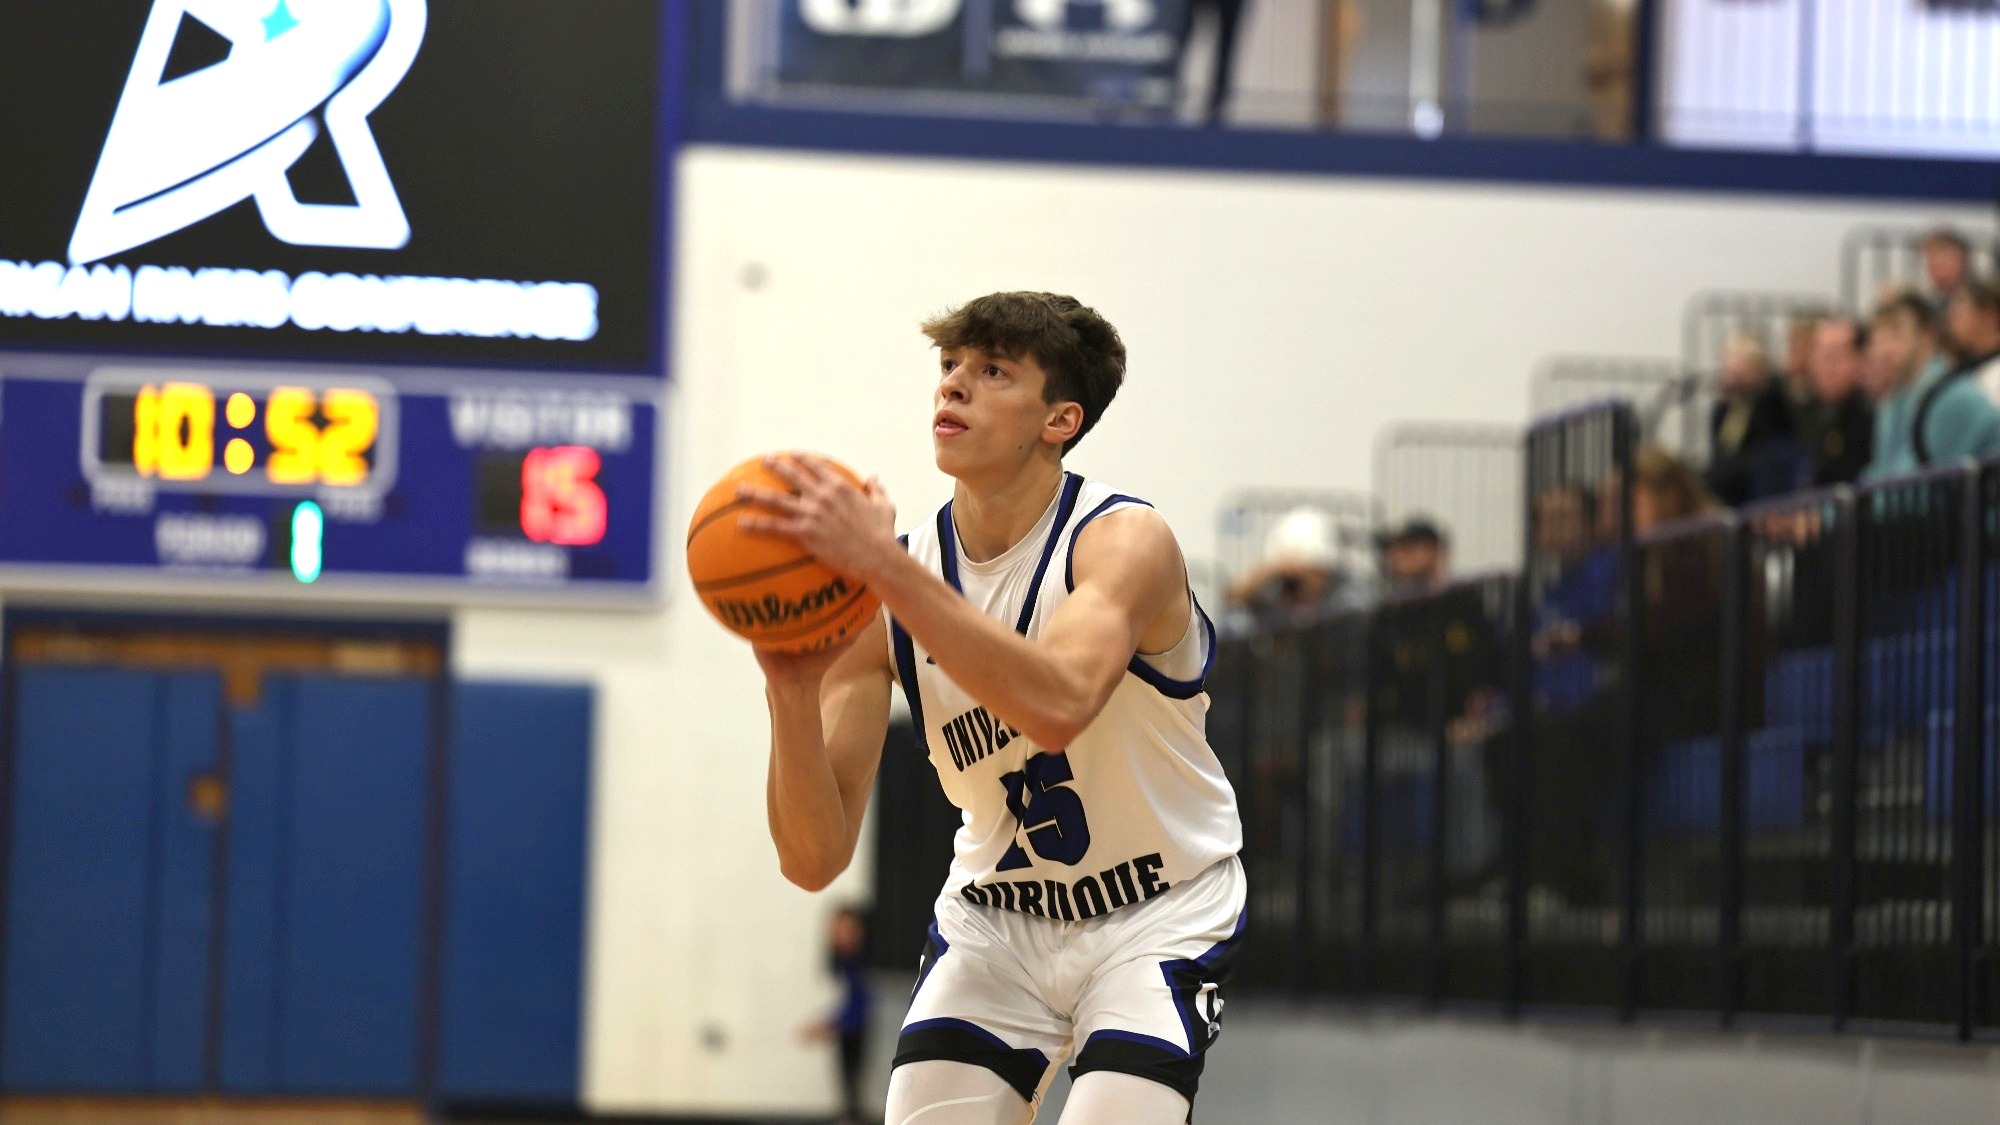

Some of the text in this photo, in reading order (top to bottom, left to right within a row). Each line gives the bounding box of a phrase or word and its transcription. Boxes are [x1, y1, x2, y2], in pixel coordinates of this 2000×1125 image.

[133, 382, 380, 486] 10:52
[291, 500, 323, 583] 1
[520, 445, 608, 546] 15
[714, 574, 848, 628] Wilson
[942, 705, 1021, 772] UNIVE
[995, 749, 1091, 873] 15
